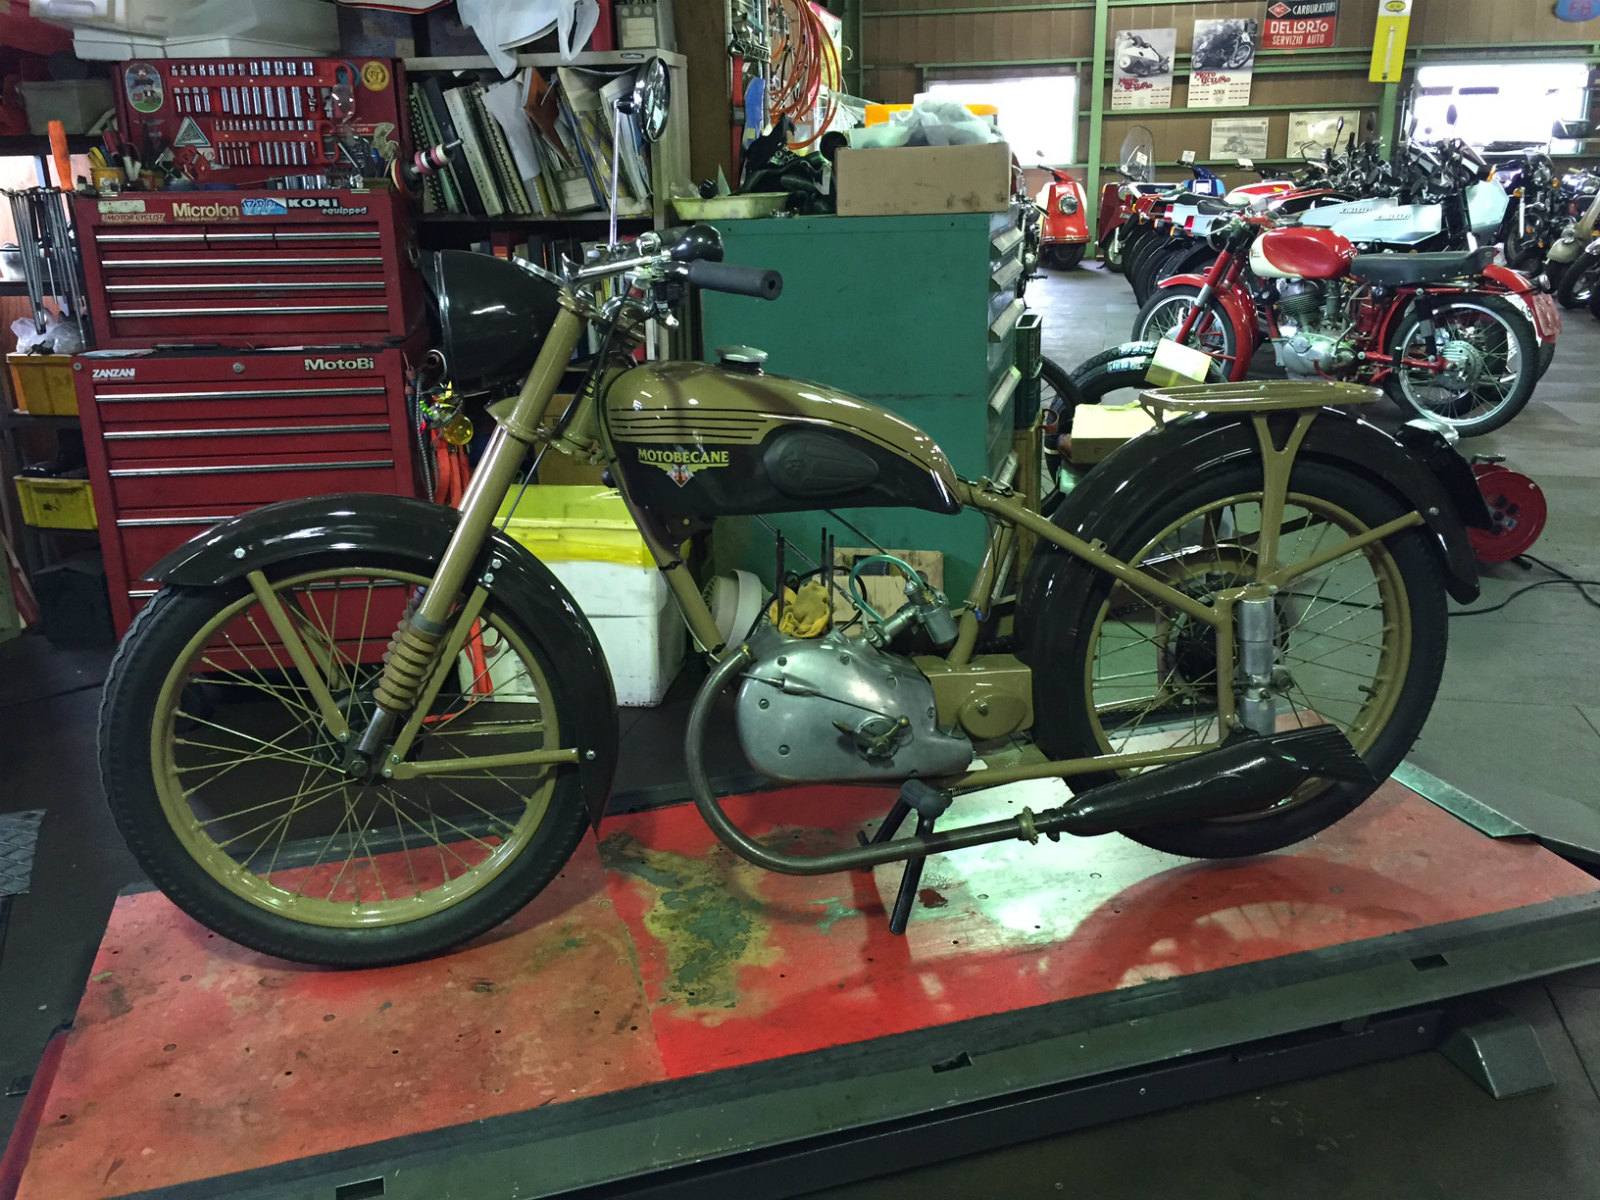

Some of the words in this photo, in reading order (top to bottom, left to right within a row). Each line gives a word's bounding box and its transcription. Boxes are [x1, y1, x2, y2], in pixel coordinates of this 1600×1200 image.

[1292, 2, 1336, 15] CARBURATORI
[1272, 35, 1304, 45] SERVIZIO
[1306, 34, 1325, 44] AUTO
[288, 198, 338, 208] KONI
[172, 202, 240, 217] Microlon
[321, 206, 367, 216] equipped
[304, 357, 375, 371] MotoBi
[92, 367, 136, 378] ZANZANI
